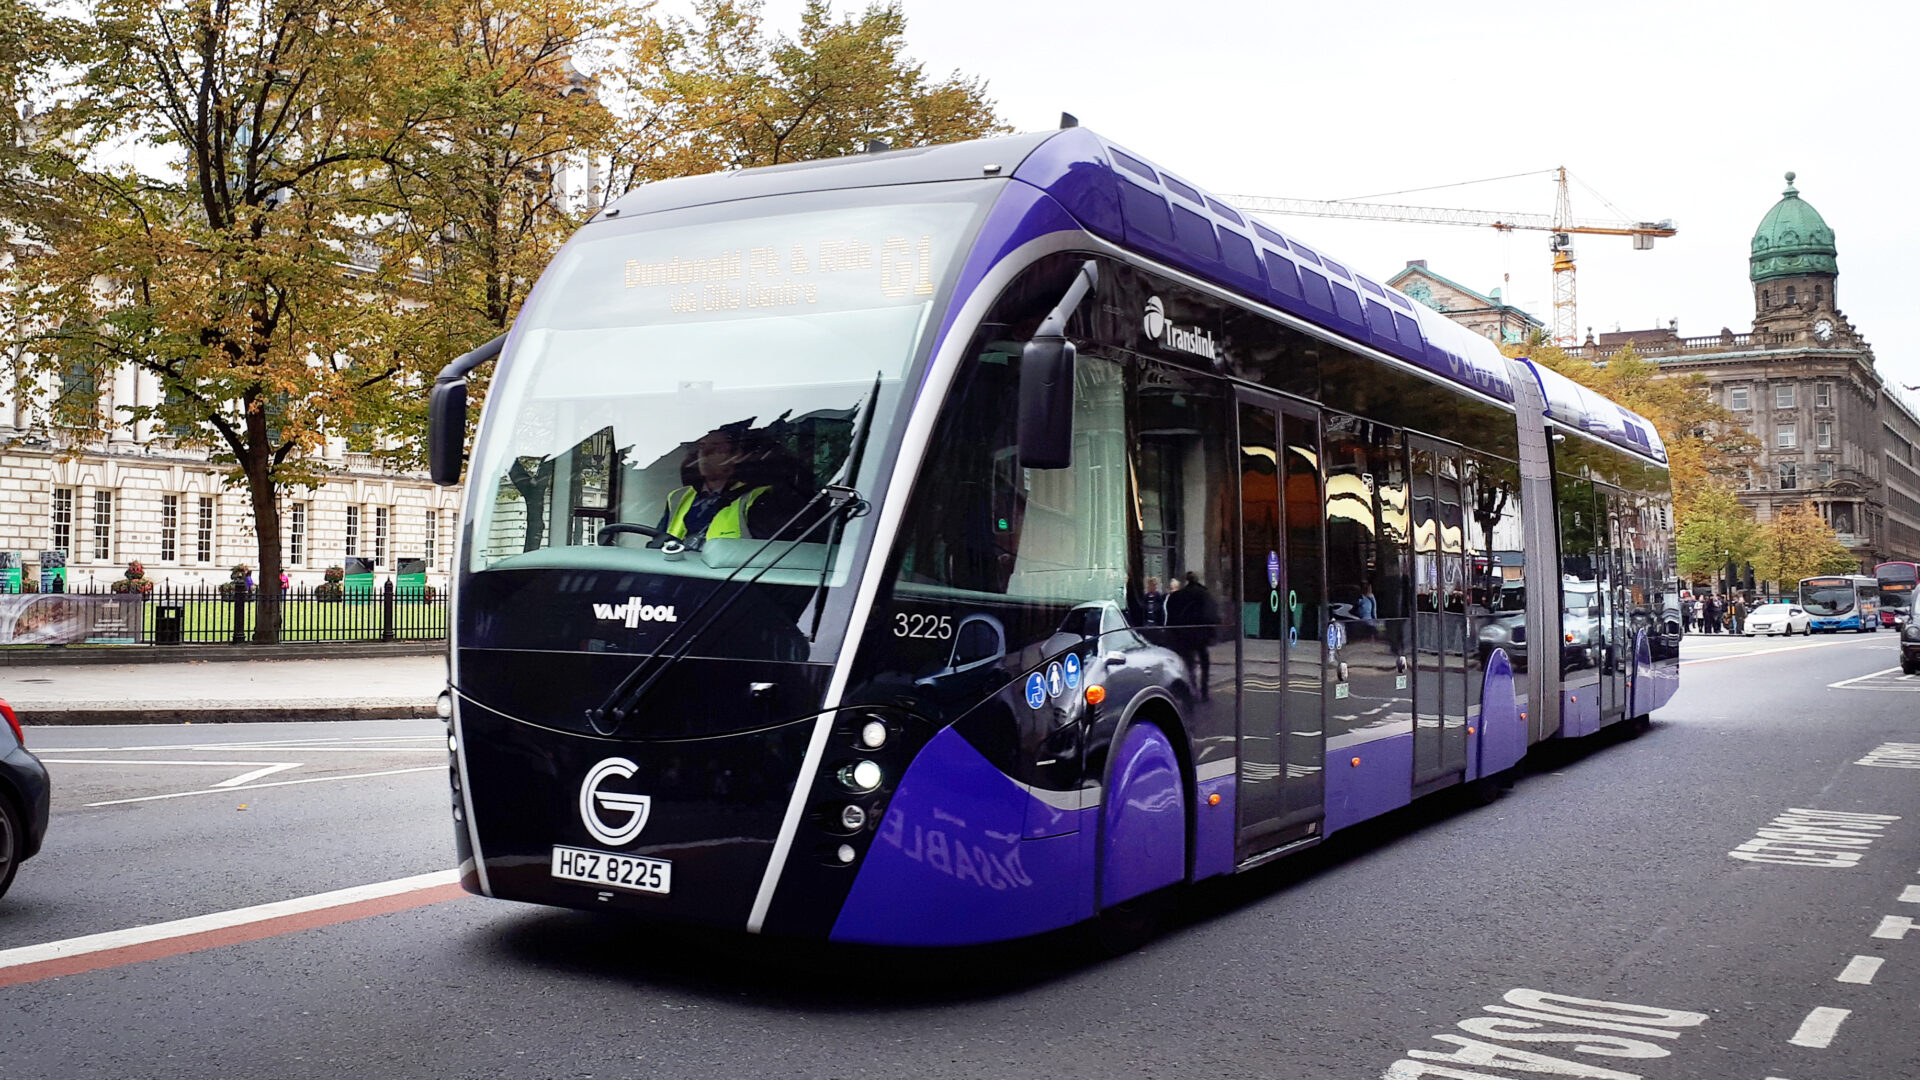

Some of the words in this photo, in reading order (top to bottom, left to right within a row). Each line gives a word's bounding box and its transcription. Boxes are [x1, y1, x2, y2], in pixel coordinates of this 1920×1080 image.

[626, 249, 742, 288] Dundonald
[881, 235, 934, 297] G1
[1164, 318, 1216, 360] Translink
[893, 612, 952, 640] 3225
[579, 756, 651, 847] G
[1727, 807, 1903, 868] DISABLED
[559, 850, 601, 881] HGZ
[606, 857, 663, 889] 8225
